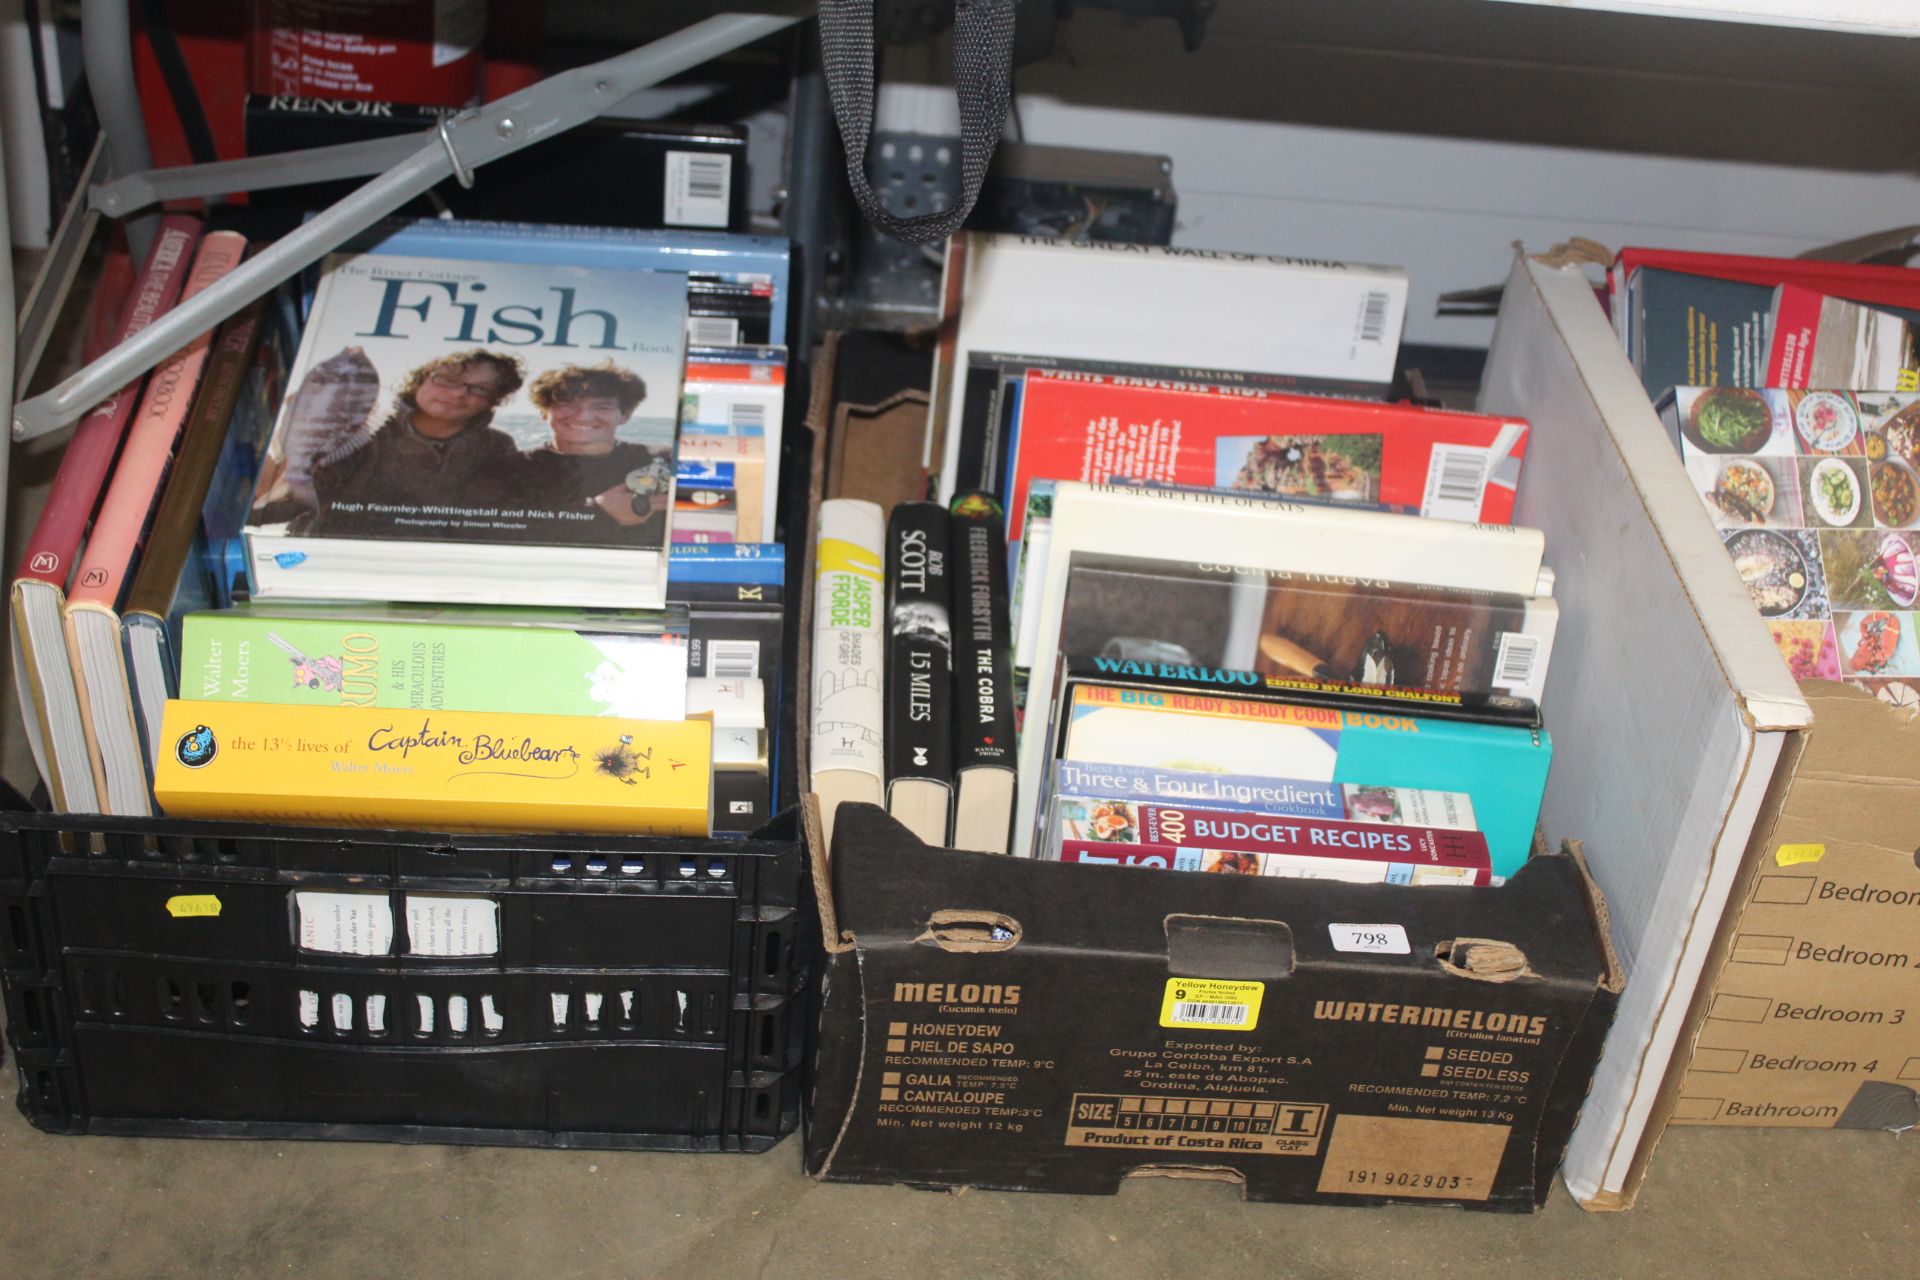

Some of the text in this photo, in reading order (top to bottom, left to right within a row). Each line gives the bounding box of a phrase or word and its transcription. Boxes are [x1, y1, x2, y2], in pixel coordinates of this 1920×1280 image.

[269, 95, 392, 117] RENOIR
[1019, 236, 1067, 249] THE
[1071, 240, 1151, 256] GREAT
[1162, 246, 1223, 261] WALL
[1230, 251, 1262, 263] OF
[1267, 254, 1349, 271] CHINA
[340, 265, 481, 283] The River Cottage
[354, 276, 628, 352] Fish
[631, 342, 675, 355] Book
[1040, 368, 1210, 392] WHITE KNUCKLE
[1177, 368, 1245, 382] ITALIAN
[1090, 483, 1305, 513] THE SECRET LIFE OF CATS
[331, 501, 596, 522] Hugh Fearnley-Whittingstall and Nick Fisher
[450, 519, 461, 529] by
[1469, 522, 1517, 534] AURUM
[901, 530, 927, 593] SCOTT
[928, 550, 943, 576] ROB
[1198, 562, 1292, 580] cocina
[831, 574, 851, 627] FFORDE
[852, 576, 872, 628] JASPER
[969, 526, 995, 724] FREDERICK FORSYTH THE COBRA
[1449, 626, 1457, 636] to
[839, 632, 850, 666] OF GREY
[851, 632, 862, 666] SHADES
[1427, 626, 1442, 680] cooking based
[203, 638, 222, 697] Walter
[231, 640, 250, 699] Moers
[392, 659, 406, 691] & HIS
[411, 641, 426, 710] MIRACULOUS
[430, 642, 446, 711] ADVENTURES
[1095, 656, 1258, 685] WATERLOO
[910, 651, 931, 722] 15 MILES
[1266, 678, 1320, 691] EDITED
[1322, 683, 1346, 693] BY
[1349, 686, 1384, 697] LORD
[1385, 690, 1461, 704] CHALFONT
[1086, 686, 1420, 733] THE BIG READY STEADY COOK BOOK
[231, 736, 256, 752] the
[296, 739, 328, 754] lives
[334, 739, 355, 754] of
[368, 718, 464, 758] Captain
[330, 760, 414, 776] Walter Moers
[1062, 767, 1337, 807] Three & Four Ingredient
[1264, 801, 1327, 816] Cookbook
[1149, 807, 1159, 843] BEST-EVER
[1159, 809, 1412, 852] 400 BUDGET RECIPES
[1420, 838, 1428, 852] LUCY
[1426, 830, 1438, 861] DONCASTER
[368, 904, 376, 928] greatest
[350, 922, 358, 934] der
[1352, 932, 1388, 946] 798
[1796, 942, 1908, 968] Bedroom
[894, 982, 1021, 1005] MELONS
[1175, 980, 1259, 991] Yellow Honeydew
[1175, 989, 1186, 999] 9
[938, 1005, 1018, 1015] (Cucumis melo)
[1314, 1000, 1547, 1035] WATERMELONS
[1774, 1002, 1905, 1025] Bedroom 3
[912, 1023, 1001, 1037] HONEYDEW
[1446, 1029, 1540, 1045] (Citrullus lanatus)
[910, 1040, 1014, 1054] PIEL DE SAPO
[1165, 1040, 1262, 1054] Exported by:
[1446, 1048, 1513, 1064] SEEDED
[885, 1056, 1030, 1068] RECOMMENDED TEMP:
[1109, 1049, 1312, 1065] Grupo Cordoba Export S.A
[1750, 1054, 1879, 1074] Bedroom 4
[1144, 1061, 1242, 1073] La km
[1442, 1065, 1530, 1083] SEEDLESS
[906, 1073, 952, 1087] GALIA
[957, 1074, 1018, 1082] RECOMMENDED
[1123, 1070, 1289, 1086] 25 m. este de Abopac.
[1205, 1082, 1268, 1094] Alajuela.
[1349, 1083, 1510, 1103] RECOMMENDED TEMP: 7.2
[904, 1090, 1005, 1105] CANTALOUPE
[878, 1104, 980, 1115] RECOMMENDED
[1078, 1103, 1113, 1120] SIZE
[1388, 1103, 1514, 1121] Min. Net weight 13 Kg
[1726, 1101, 1838, 1118] Bathroom
[877, 1118, 1024, 1132] Min. Net weight 12 kg
[1123, 1117, 1267, 1132] 5 6 7 8 9 10 12
[1083, 1132, 1263, 1150] Product of Costa Rica
[1276, 1139, 1309, 1147] CLASS
